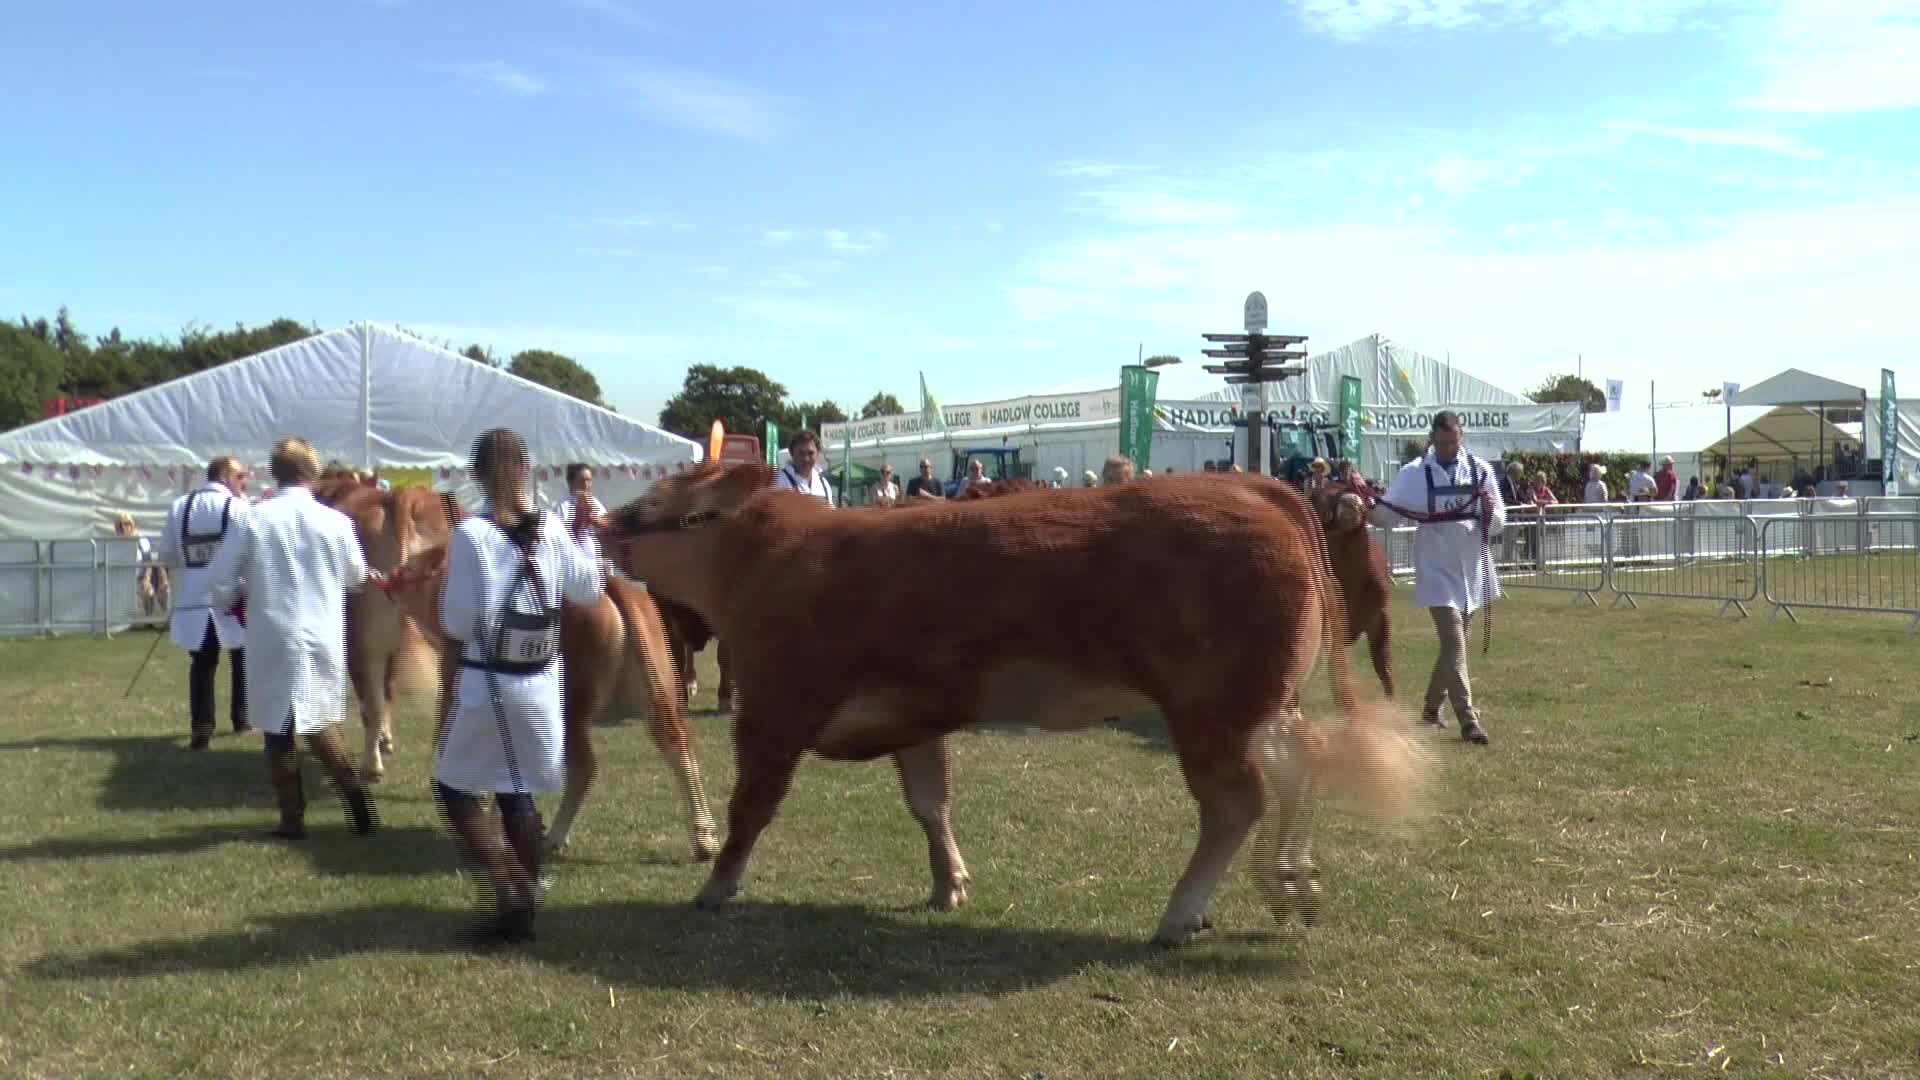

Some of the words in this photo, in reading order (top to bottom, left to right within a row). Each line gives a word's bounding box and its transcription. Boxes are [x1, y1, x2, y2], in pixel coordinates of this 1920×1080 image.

[989, 403, 1032, 425] HADLOW
[1034, 401, 1081, 419] COLLEGE
[1457, 411, 1510, 427] OLLEGE
[1345, 407, 1359, 453] Apply
